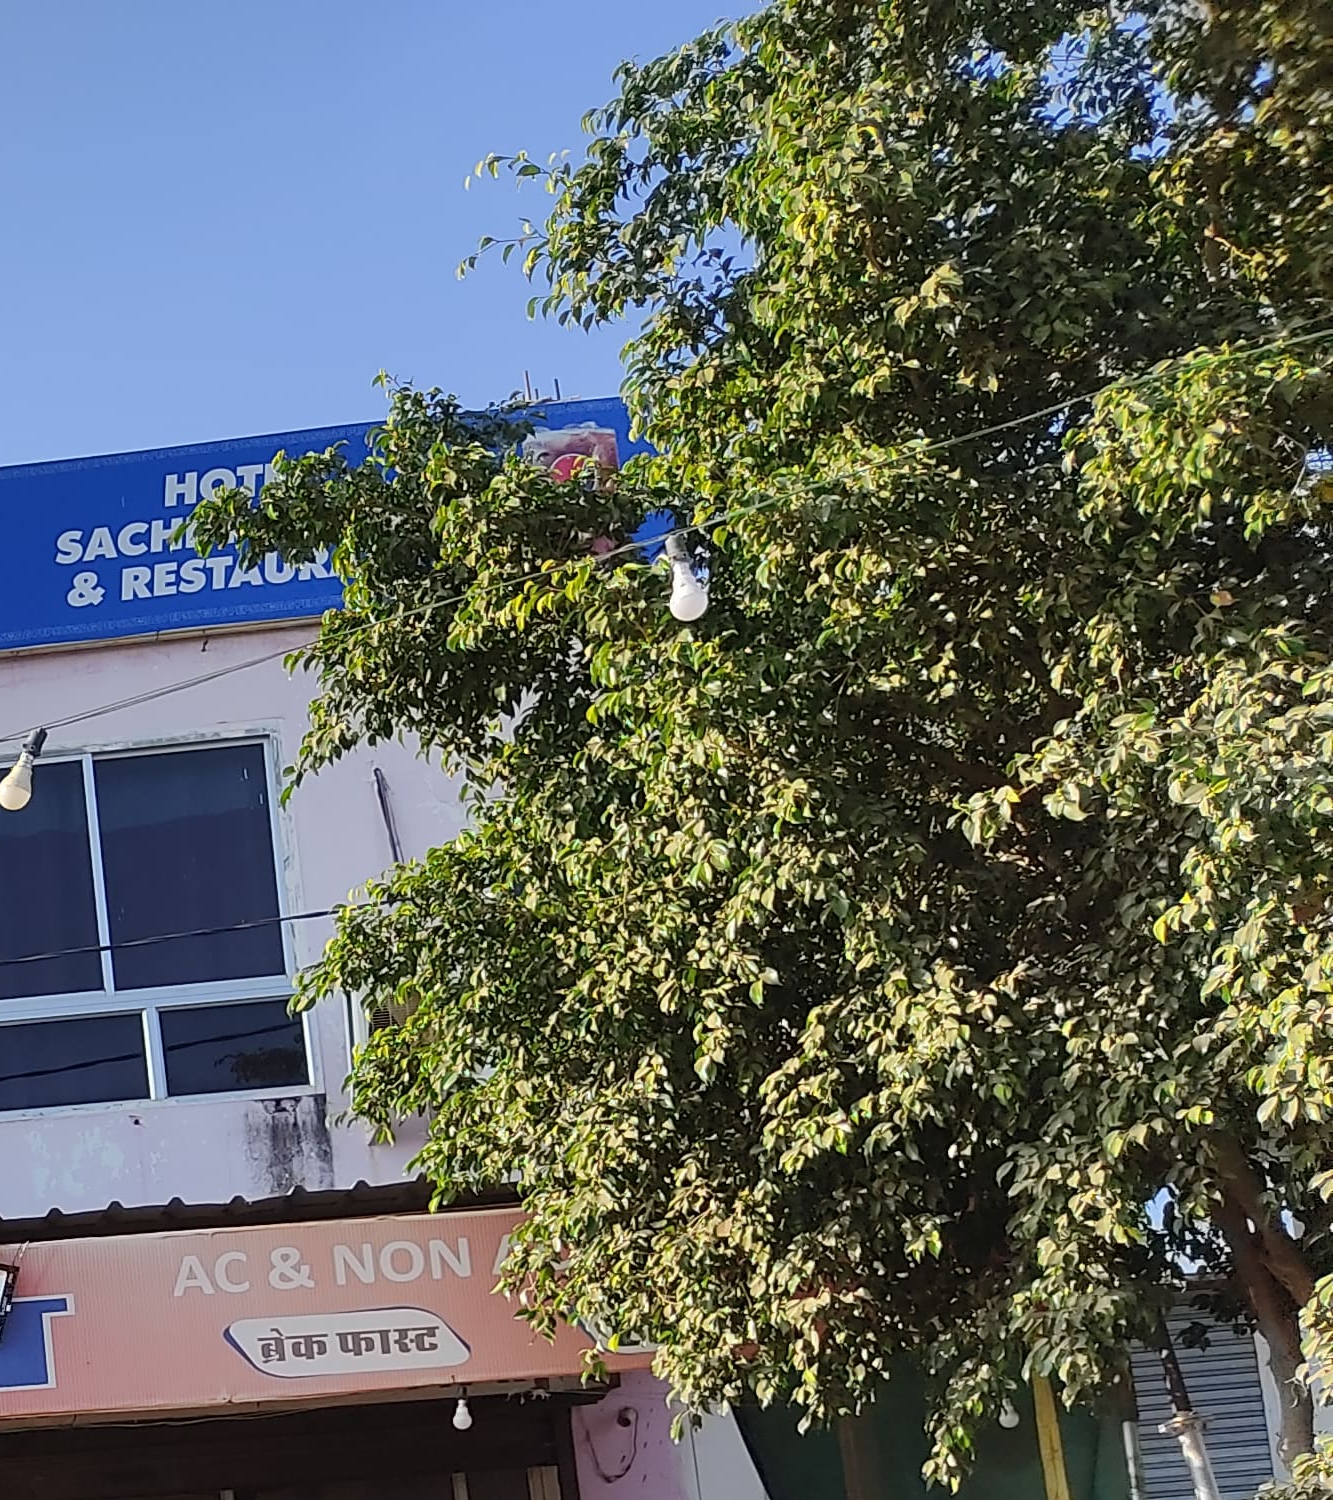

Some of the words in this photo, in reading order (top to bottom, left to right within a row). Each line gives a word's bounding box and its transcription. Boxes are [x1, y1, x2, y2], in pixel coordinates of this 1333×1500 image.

[164, 463, 278, 508] HOT
[55, 515, 236, 565] SACH
[67, 571, 106, 607] &
[121, 548, 341, 602] RESTAUR
[173, 1251, 251, 1297] AC
[268, 1246, 315, 1290] &
[332, 1236, 473, 1286] NON
[256, 1327, 329, 1364] ब्रेक
[334, 1325, 440, 1357] फास्ट
